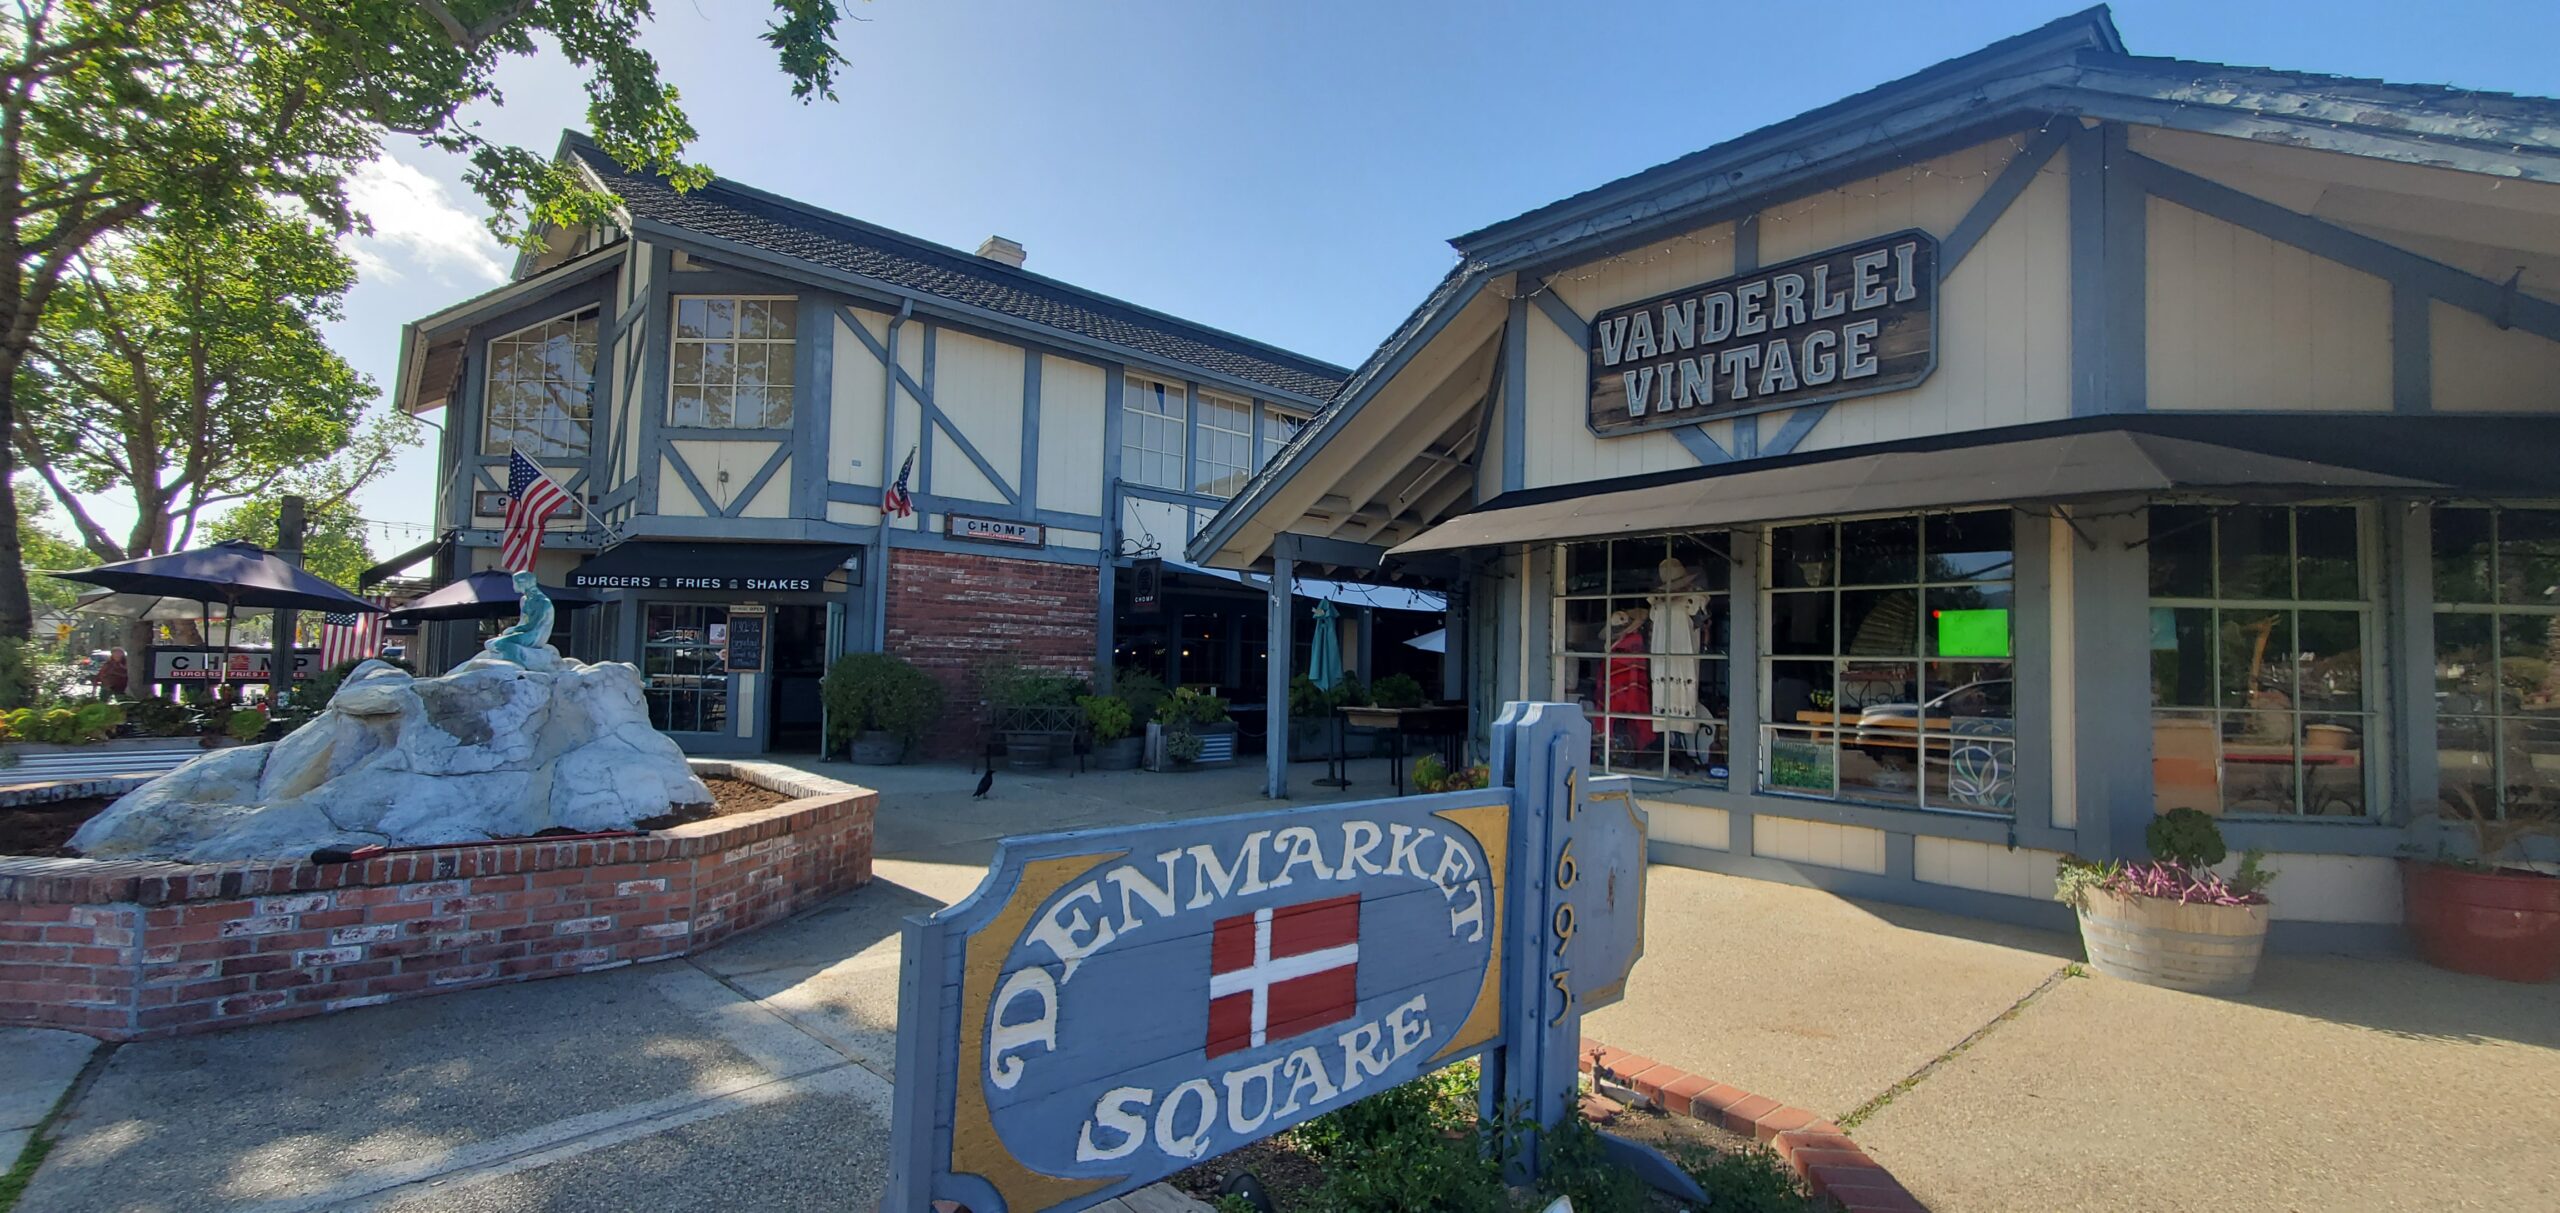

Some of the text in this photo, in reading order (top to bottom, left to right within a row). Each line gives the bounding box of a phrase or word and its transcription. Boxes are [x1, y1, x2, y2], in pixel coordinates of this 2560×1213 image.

[1599, 241, 1917, 367] VANDERLEI
[1623, 317, 1879, 418] VINTAGE
[577, 575, 810, 590] BURGERS FRIES SHAKES
[968, 521, 1026, 536] CHOMP
[171, 655, 308, 670] CHMP
[1549, 766, 1578, 1028] 1693
[988, 820, 1485, 1090] DENMARKET
[1075, 993, 1434, 1163] SQUARE
